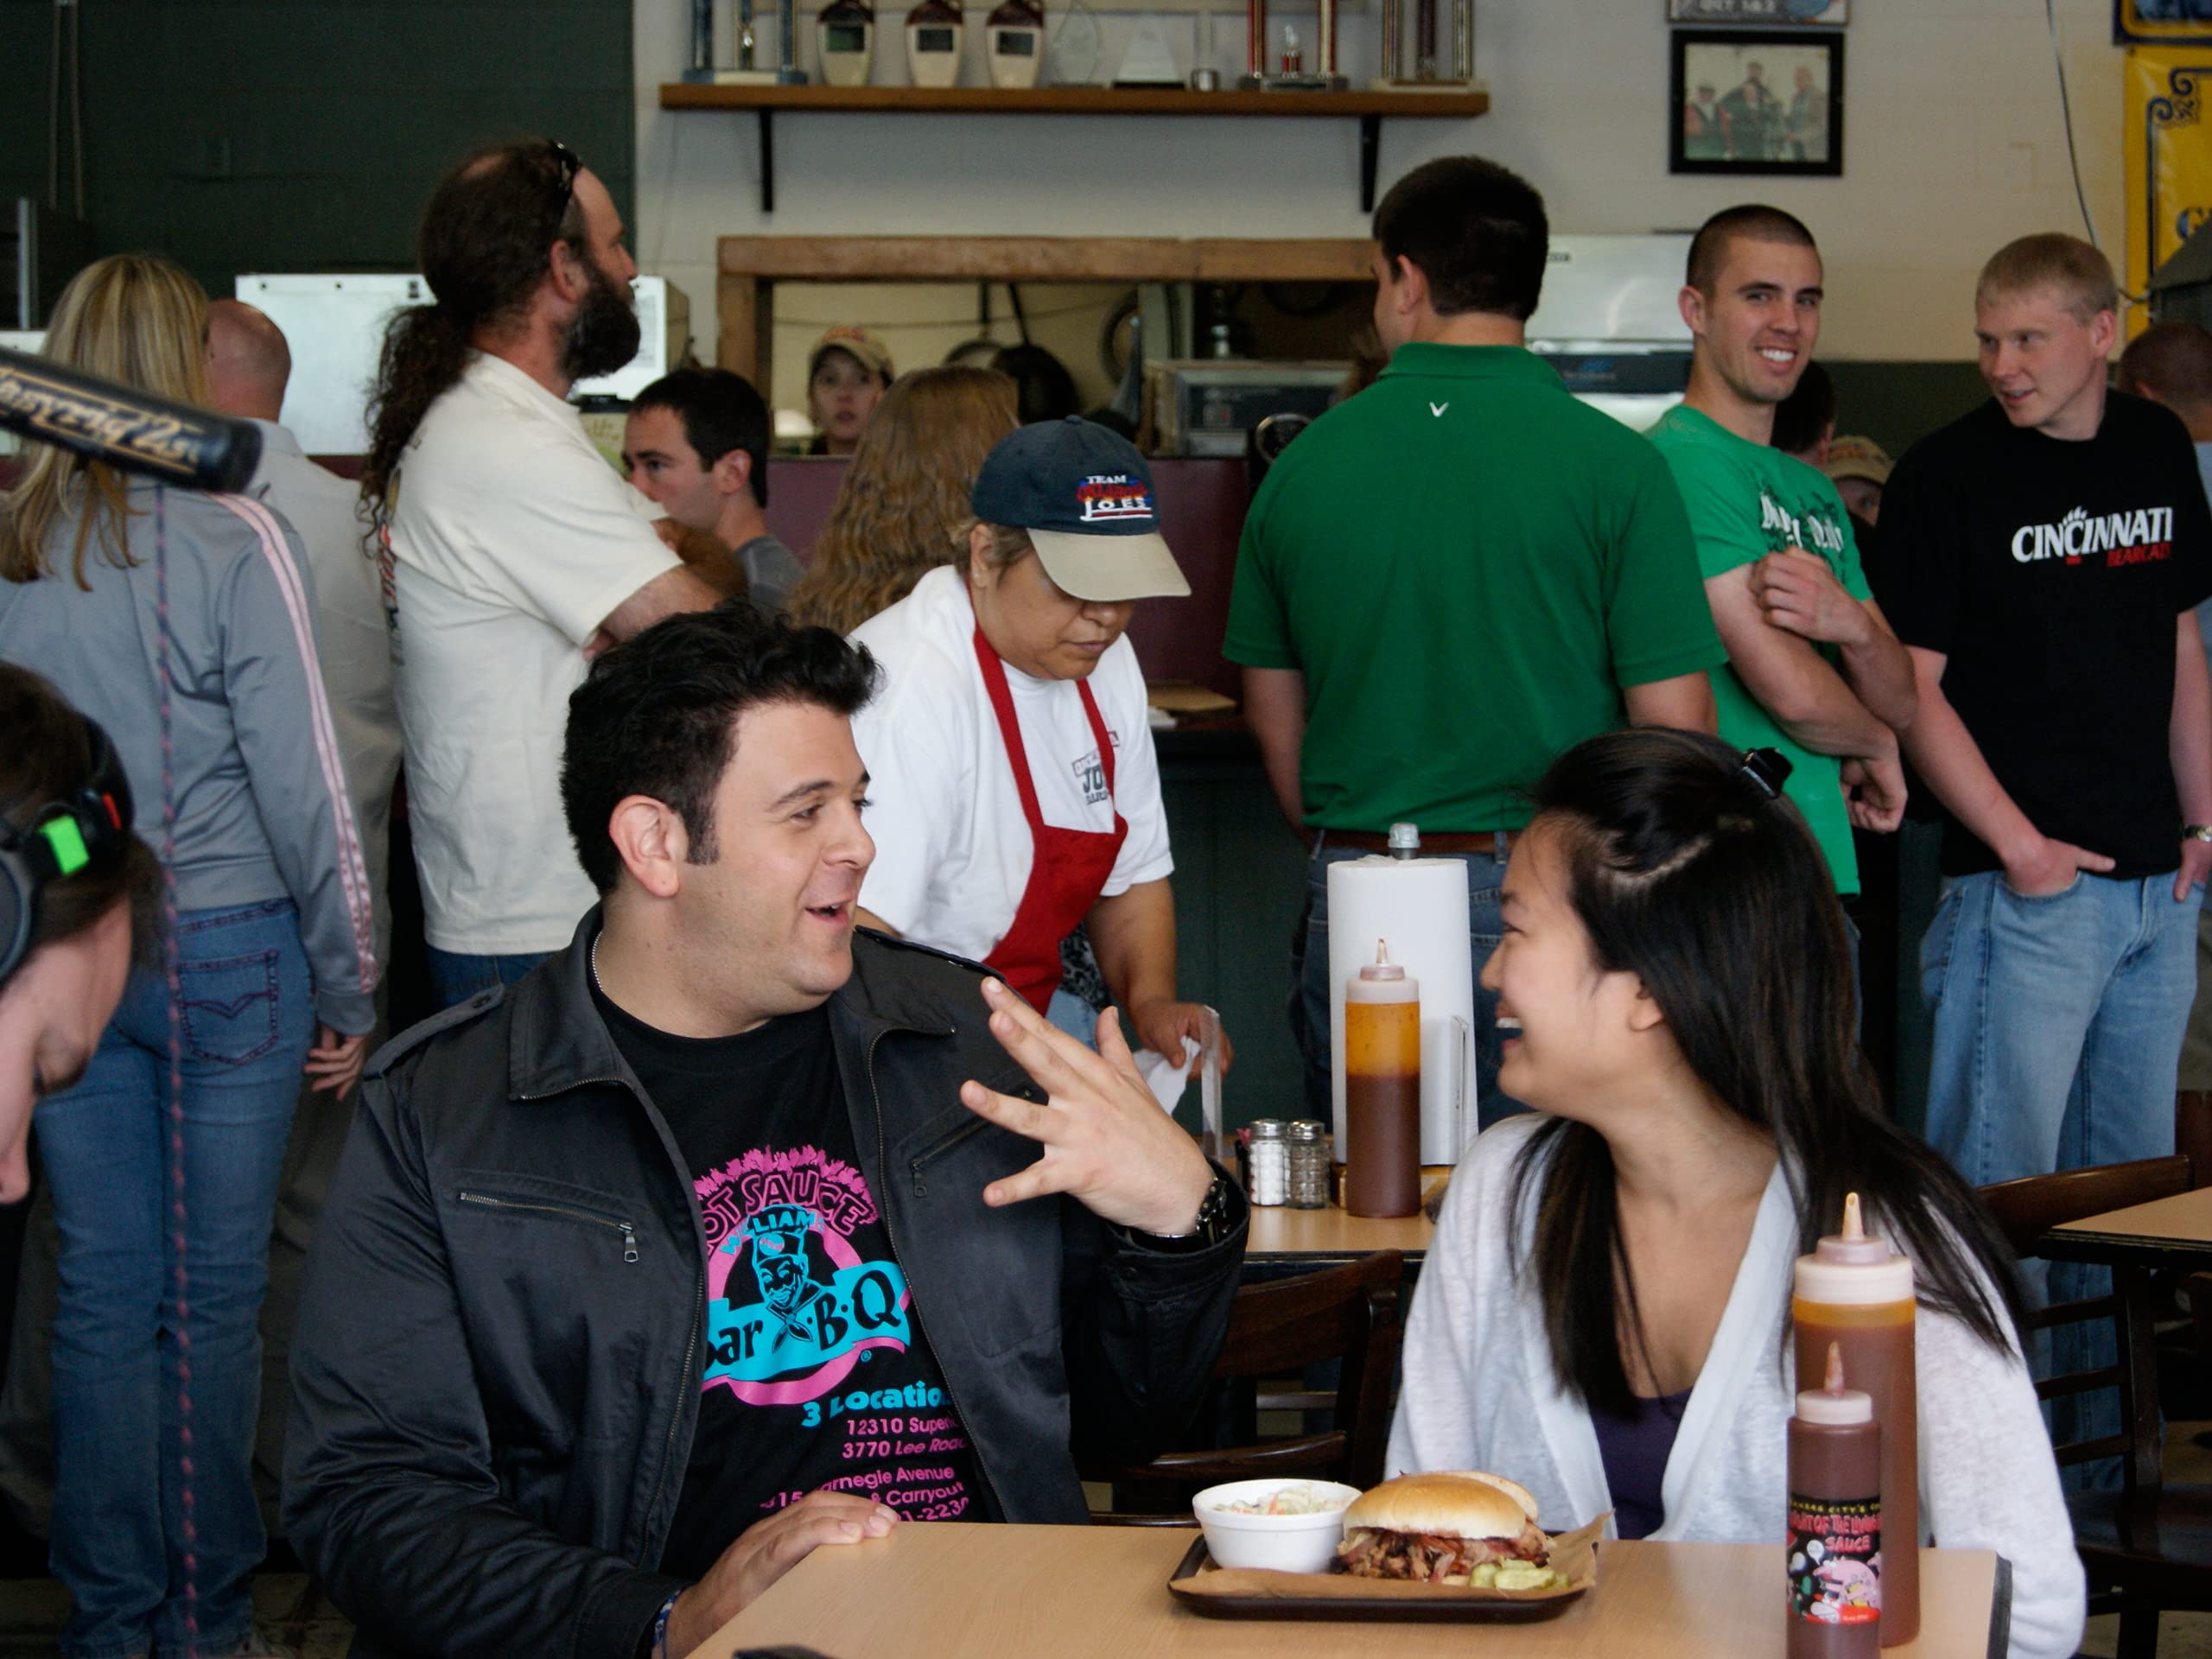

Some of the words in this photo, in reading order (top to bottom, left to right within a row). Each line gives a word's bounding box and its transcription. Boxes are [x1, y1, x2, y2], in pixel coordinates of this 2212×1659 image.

[1086, 474, 1127, 485] TEAM
[2012, 506, 2173, 563] CINCINNATI
[741, 1169, 870, 1236] SAUCE
[801, 1402, 822, 1428] 3
[847, 1418, 903, 1436] 12310
[842, 1441, 890, 1459] 3770
[895, 1440, 926, 1455] Lee
[896, 1466, 955, 1483] Avenue
[886, 1481, 965, 1506] Carryout
[1824, 1535, 1871, 1554] SAUCE
